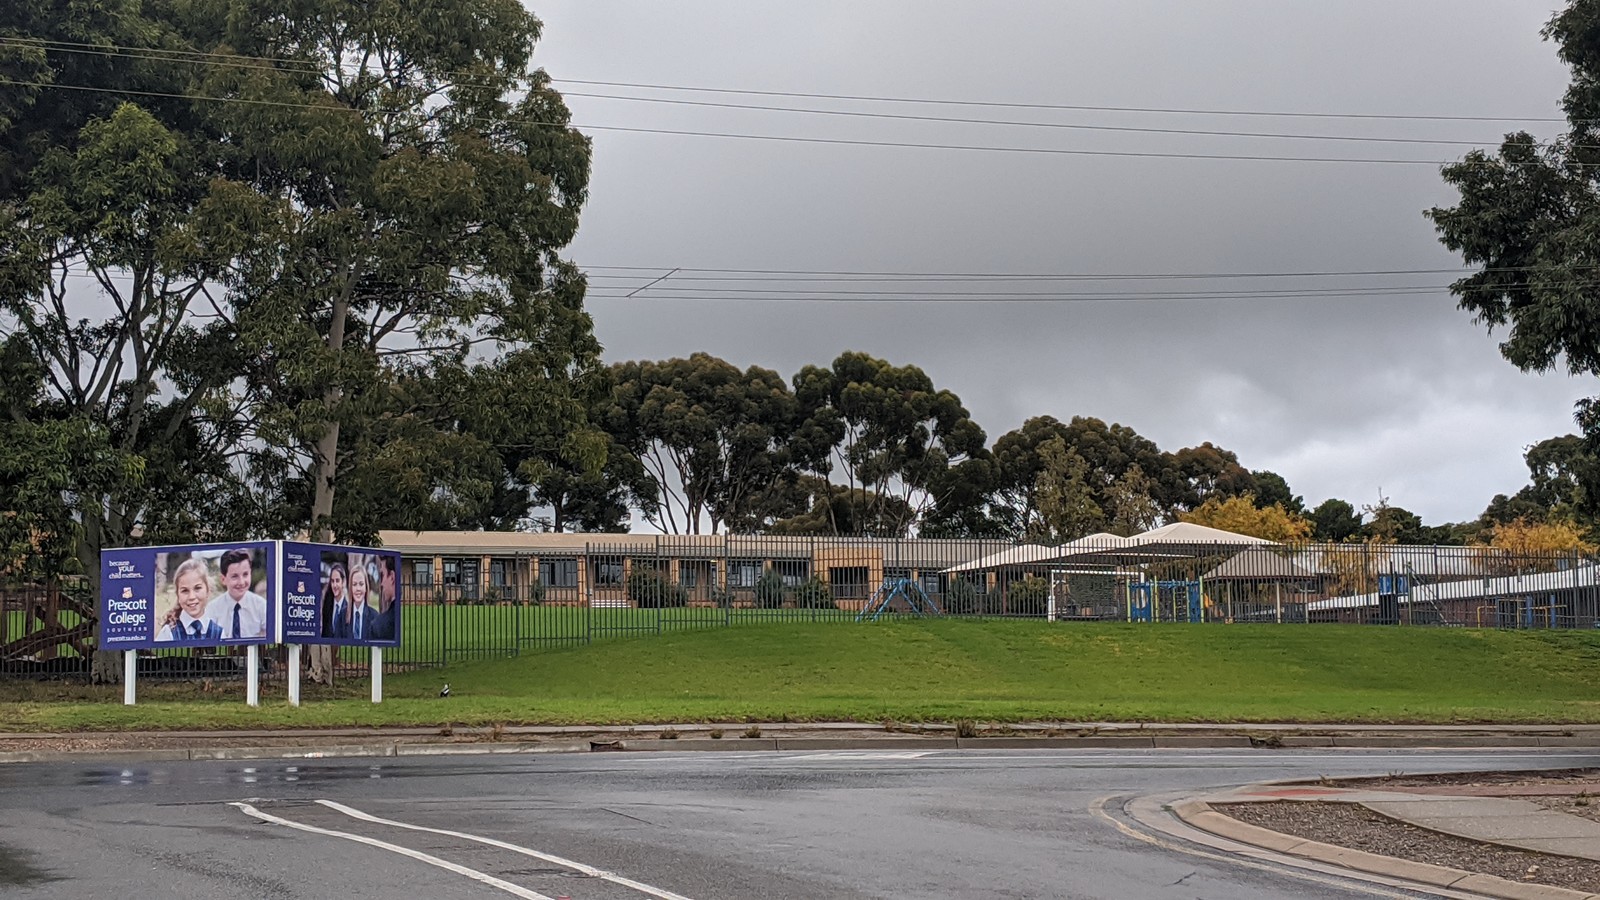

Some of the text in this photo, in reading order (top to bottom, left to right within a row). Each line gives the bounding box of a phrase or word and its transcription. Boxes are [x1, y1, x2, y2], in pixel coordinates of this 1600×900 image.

[118, 565, 135, 578] your
[109, 599, 147, 611] Prescott
[288, 592, 315, 605] Prescott
[109, 611, 146, 626] College
[288, 606, 315, 621] College
